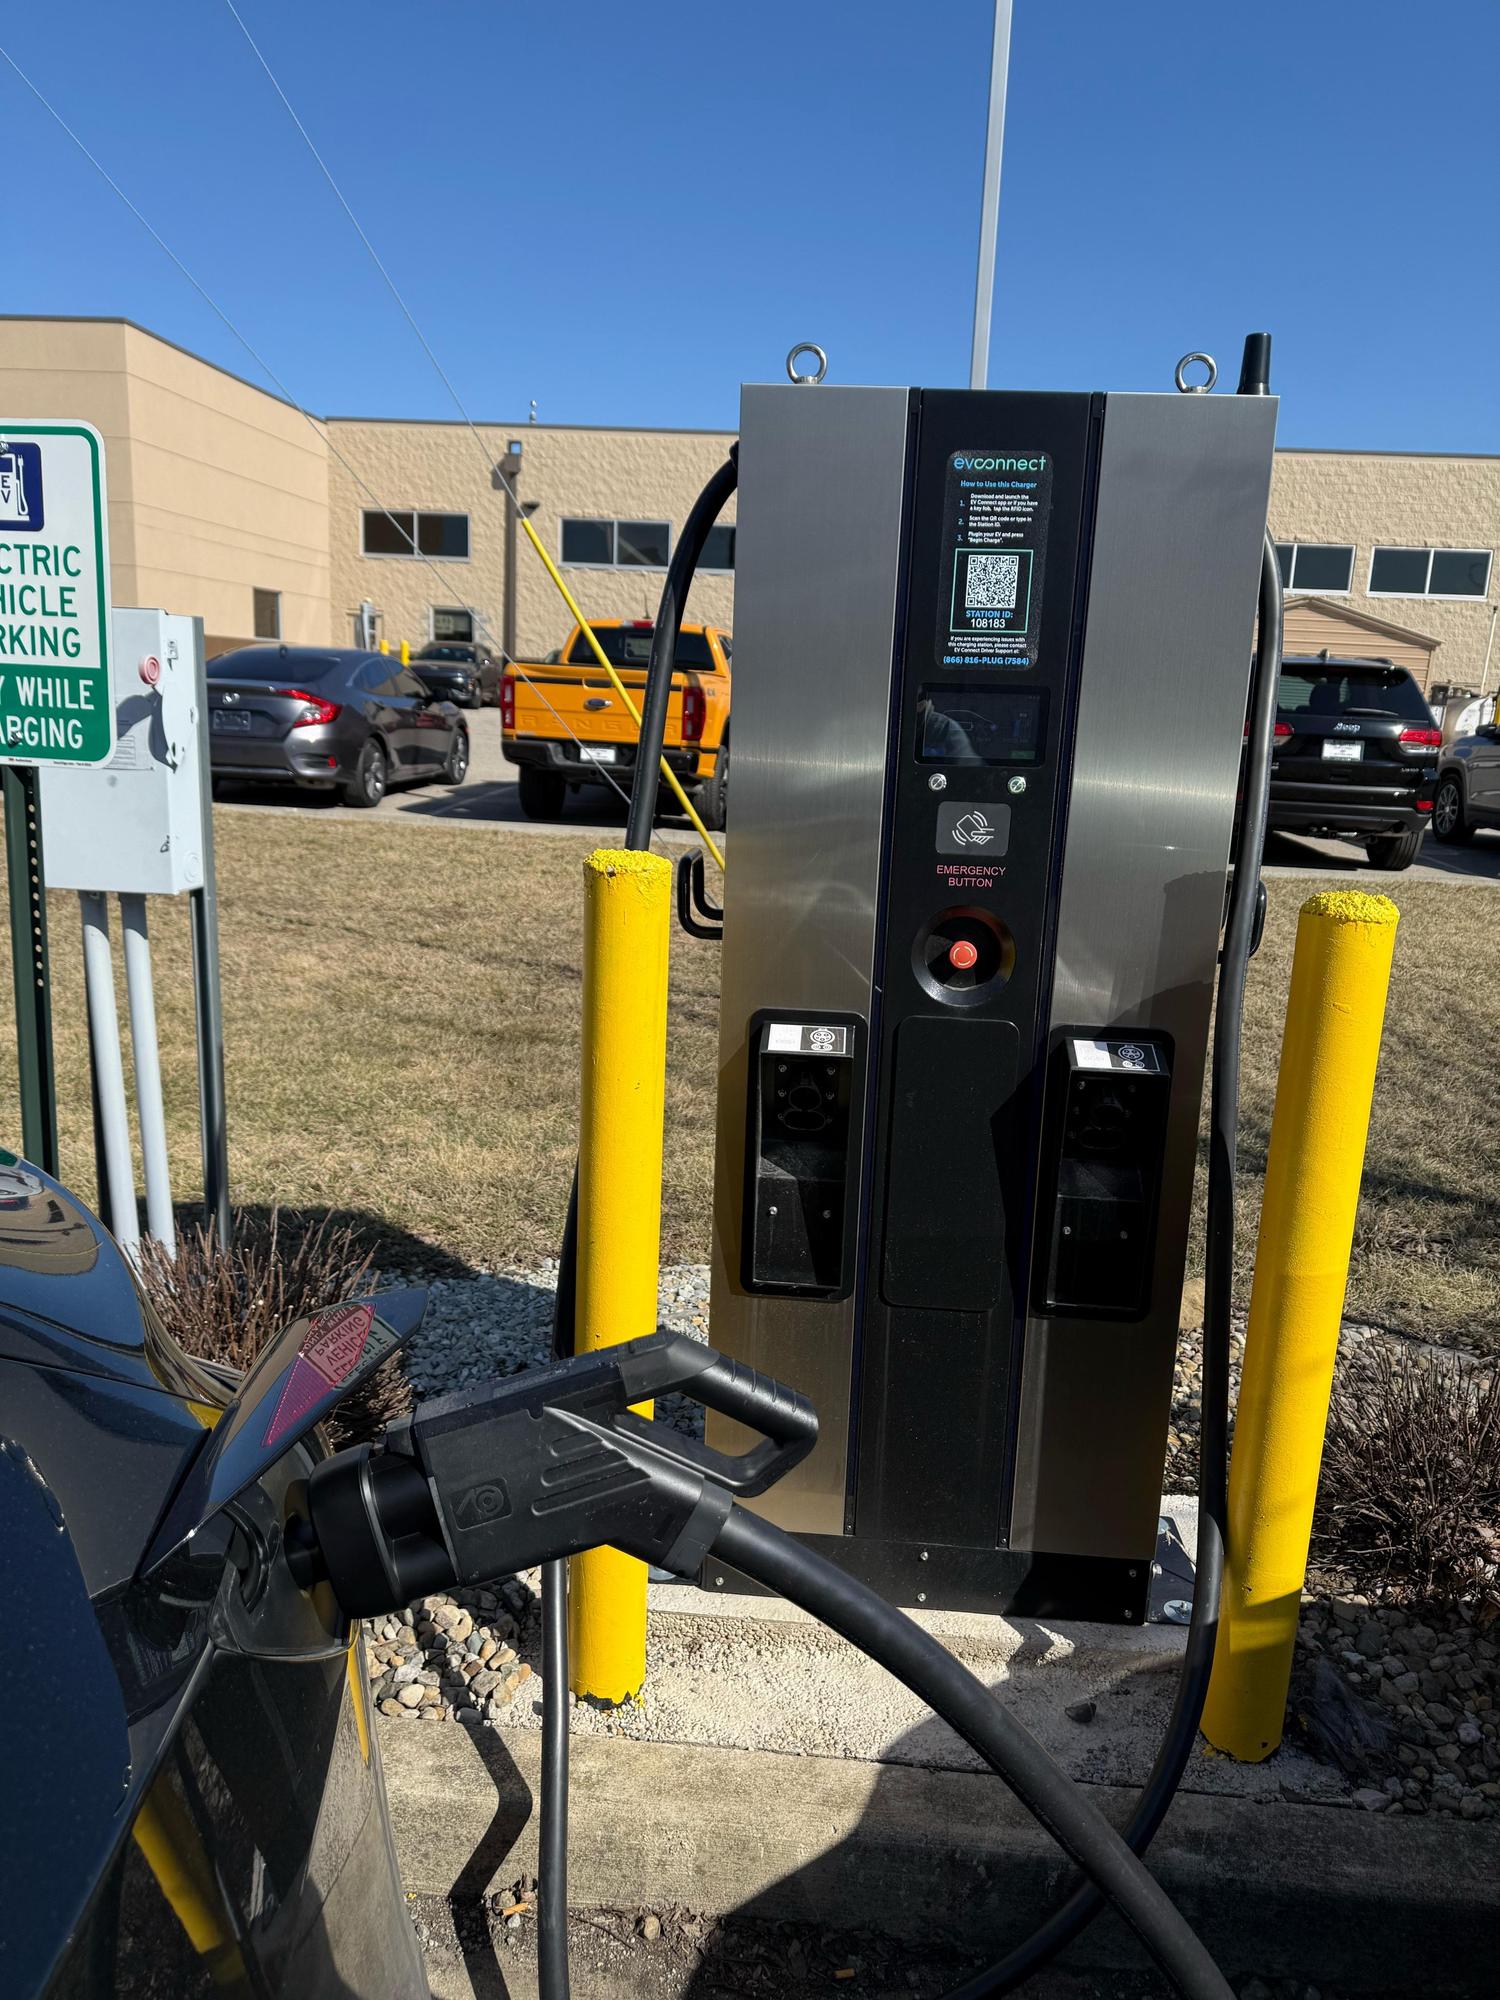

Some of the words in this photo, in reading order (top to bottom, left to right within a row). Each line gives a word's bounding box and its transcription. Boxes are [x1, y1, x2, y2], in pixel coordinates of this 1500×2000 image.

[953, 456, 1046, 470] evconnect
[1010, 481, 1037, 489] Charger
[966, 610, 1000, 618] STATION
[971, 618, 1006, 628] 108183
[943, 655, 964, 664] (866)
[964, 656, 1004, 664] 816-PLUG
[1005, 657, 1029, 665] (7584)
[16, 676, 95, 710] WHILE
[936, 864, 1006, 876] EMERGENCY
[948, 877, 993, 887] BUTTON
